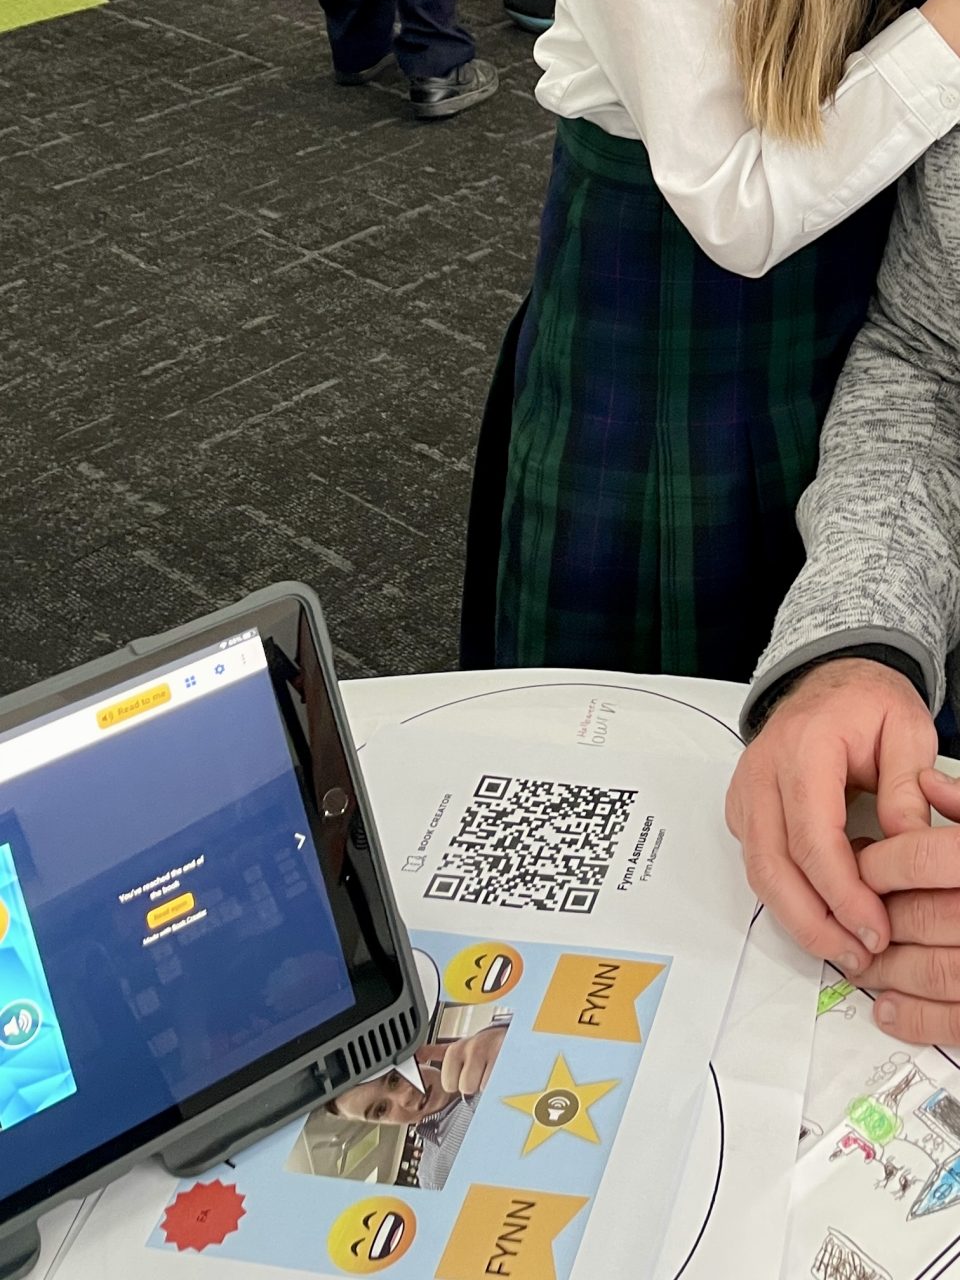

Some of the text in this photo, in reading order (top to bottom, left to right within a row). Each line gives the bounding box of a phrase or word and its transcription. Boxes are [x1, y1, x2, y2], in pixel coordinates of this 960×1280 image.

[118, 690, 166, 716] Read to me
[418, 793, 452, 851] BOOK CREATOR
[143, 872, 170, 891] reached
[171, 867, 182, 878] the
[183, 859, 196, 873] end
[617, 816, 654, 891] Fynn Asmussen
[640, 829, 666, 881] Fynn Asmussen
[578, 963, 620, 1026] FYNN
[485, 1199, 536, 1276] FYNN
